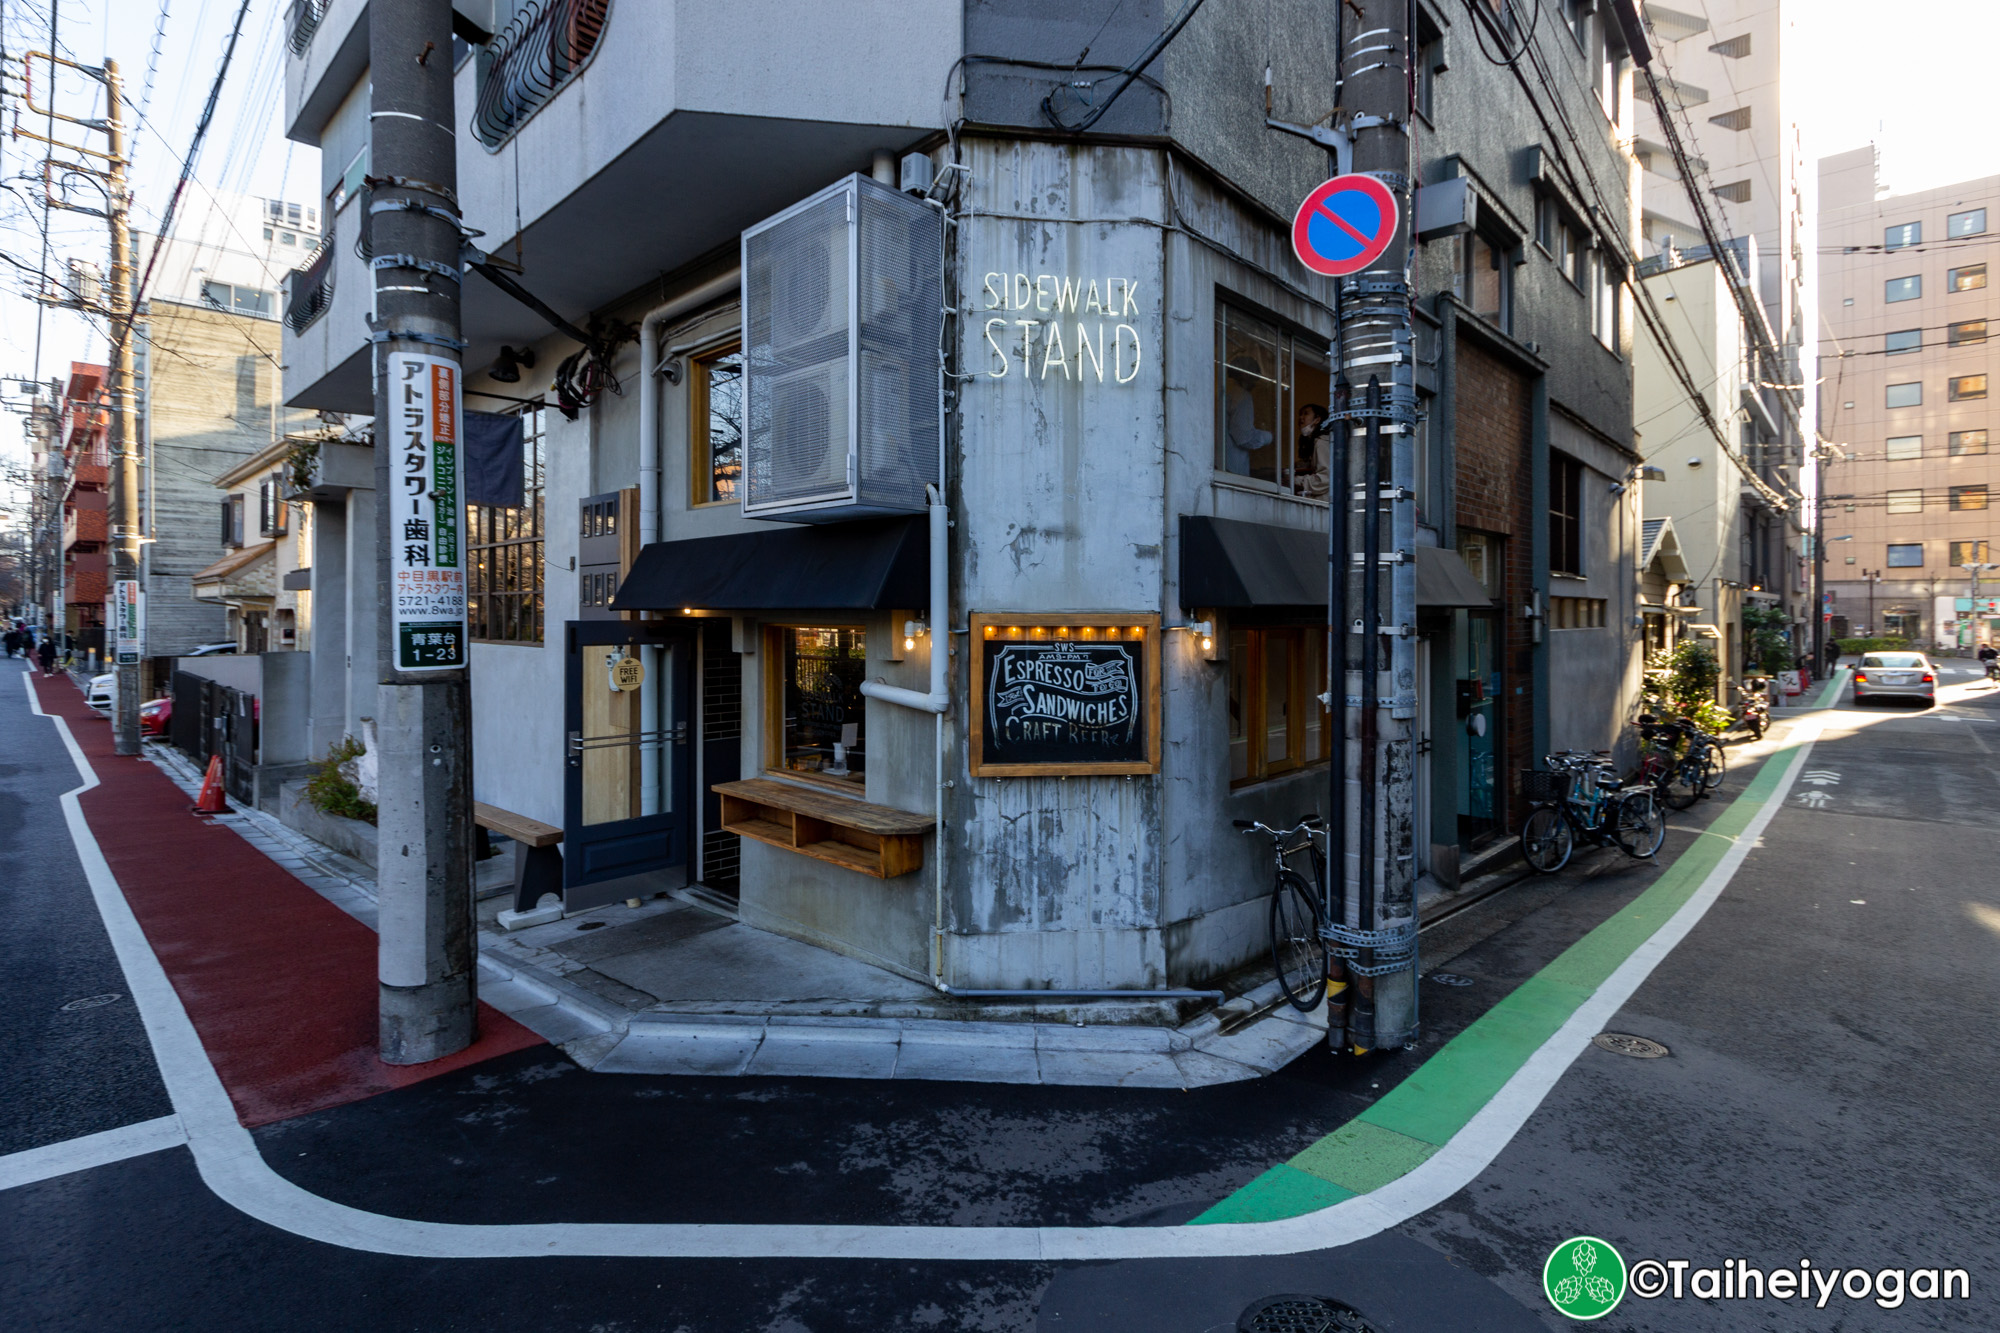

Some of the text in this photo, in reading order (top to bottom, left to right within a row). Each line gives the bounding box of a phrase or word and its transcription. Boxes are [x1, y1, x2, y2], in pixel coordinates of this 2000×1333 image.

[985, 272, 1139, 316] SIDEWALK
[986, 318, 1141, 383] STAND
[402, 361, 430, 567] アトラスタワー歯科
[398, 571, 463, 582] 中目黒駅前
[398, 583, 463, 594] アトラスタワー内
[399, 596, 463, 606] 5721-4188
[399, 606, 463, 616] www.8wa.jp
[411, 633, 456, 646] 青葉台
[1054, 642, 1075, 652] SWS
[412, 648, 457, 661] 1-23
[620, 667, 639, 675] FREE
[1004, 654, 1085, 692] ESPRESSO
[1022, 684, 1128, 724] SANDWICHES
[801, 702, 844, 722] STAND
[1005, 716, 1062, 742] CRAFT
